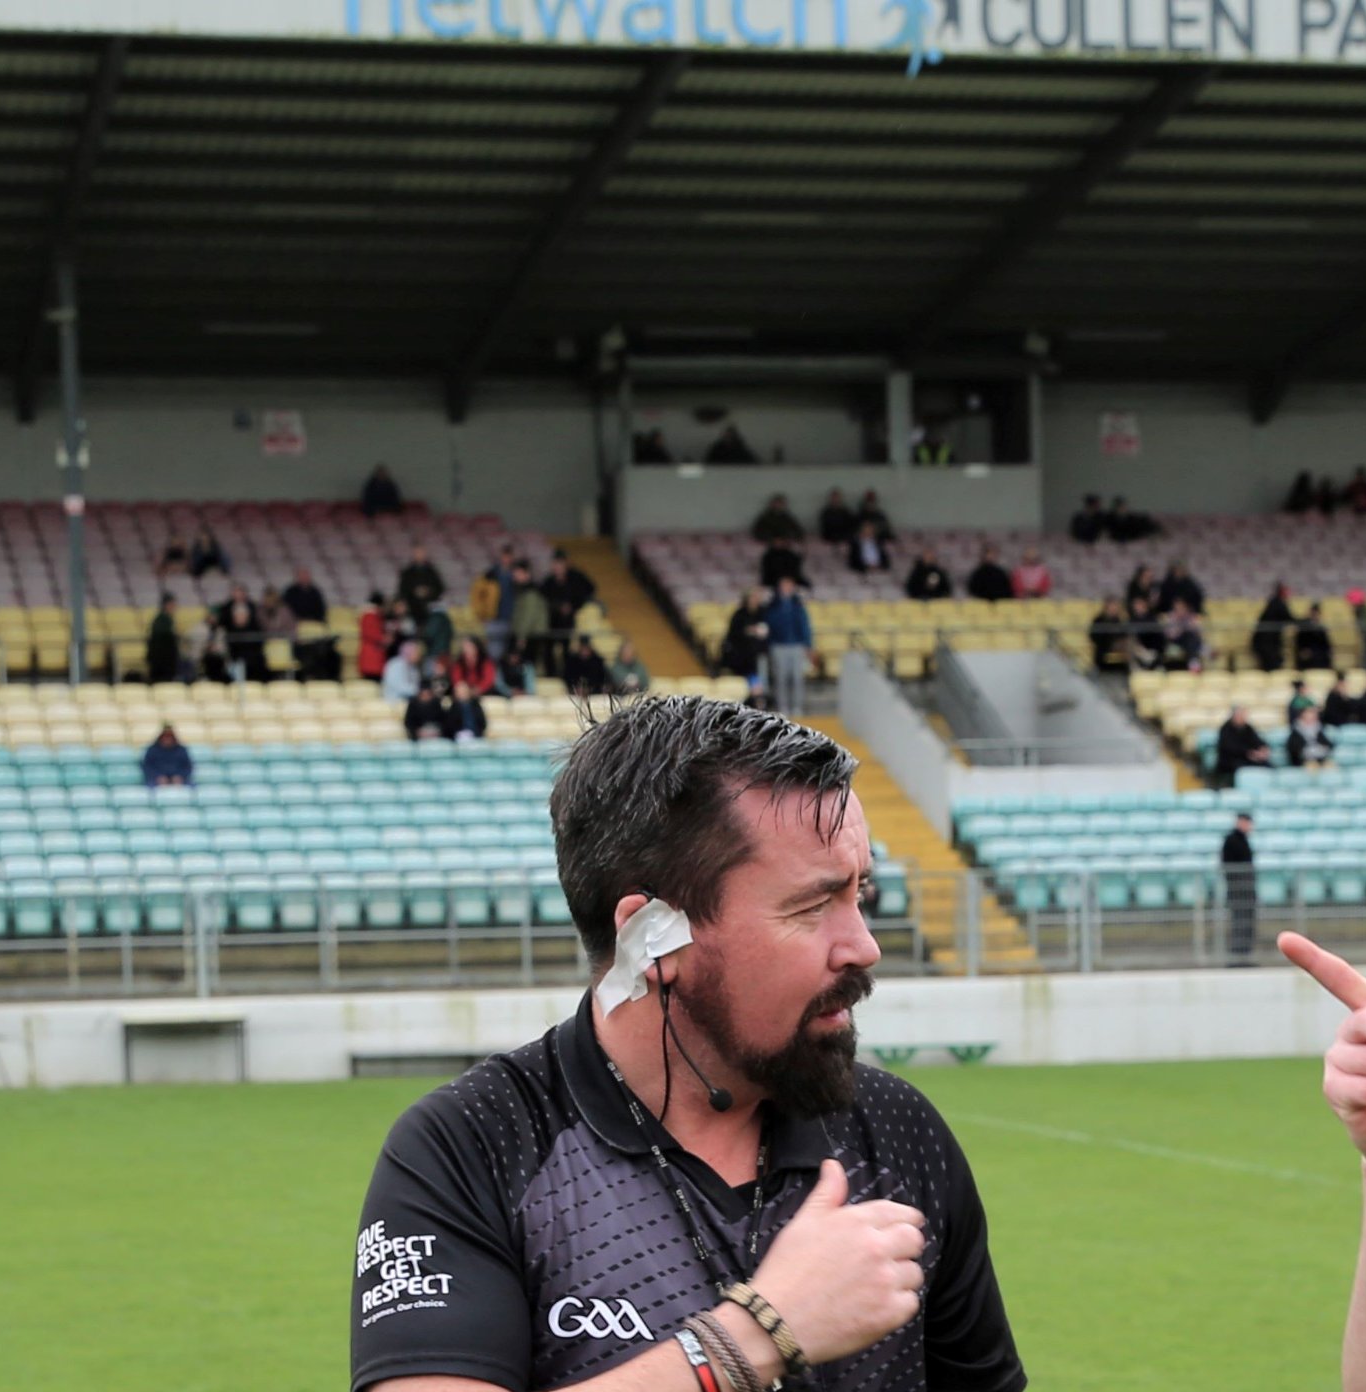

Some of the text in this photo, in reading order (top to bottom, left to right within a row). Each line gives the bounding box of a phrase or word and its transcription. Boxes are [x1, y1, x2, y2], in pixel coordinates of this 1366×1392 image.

[982, 0, 1254, 53] CULLEN
[357, 1235, 437, 1278] RESPECT
[380, 1256, 423, 1280] GET
[362, 1273, 454, 1314] RESPECT
[547, 1296, 655, 1342] GAA
